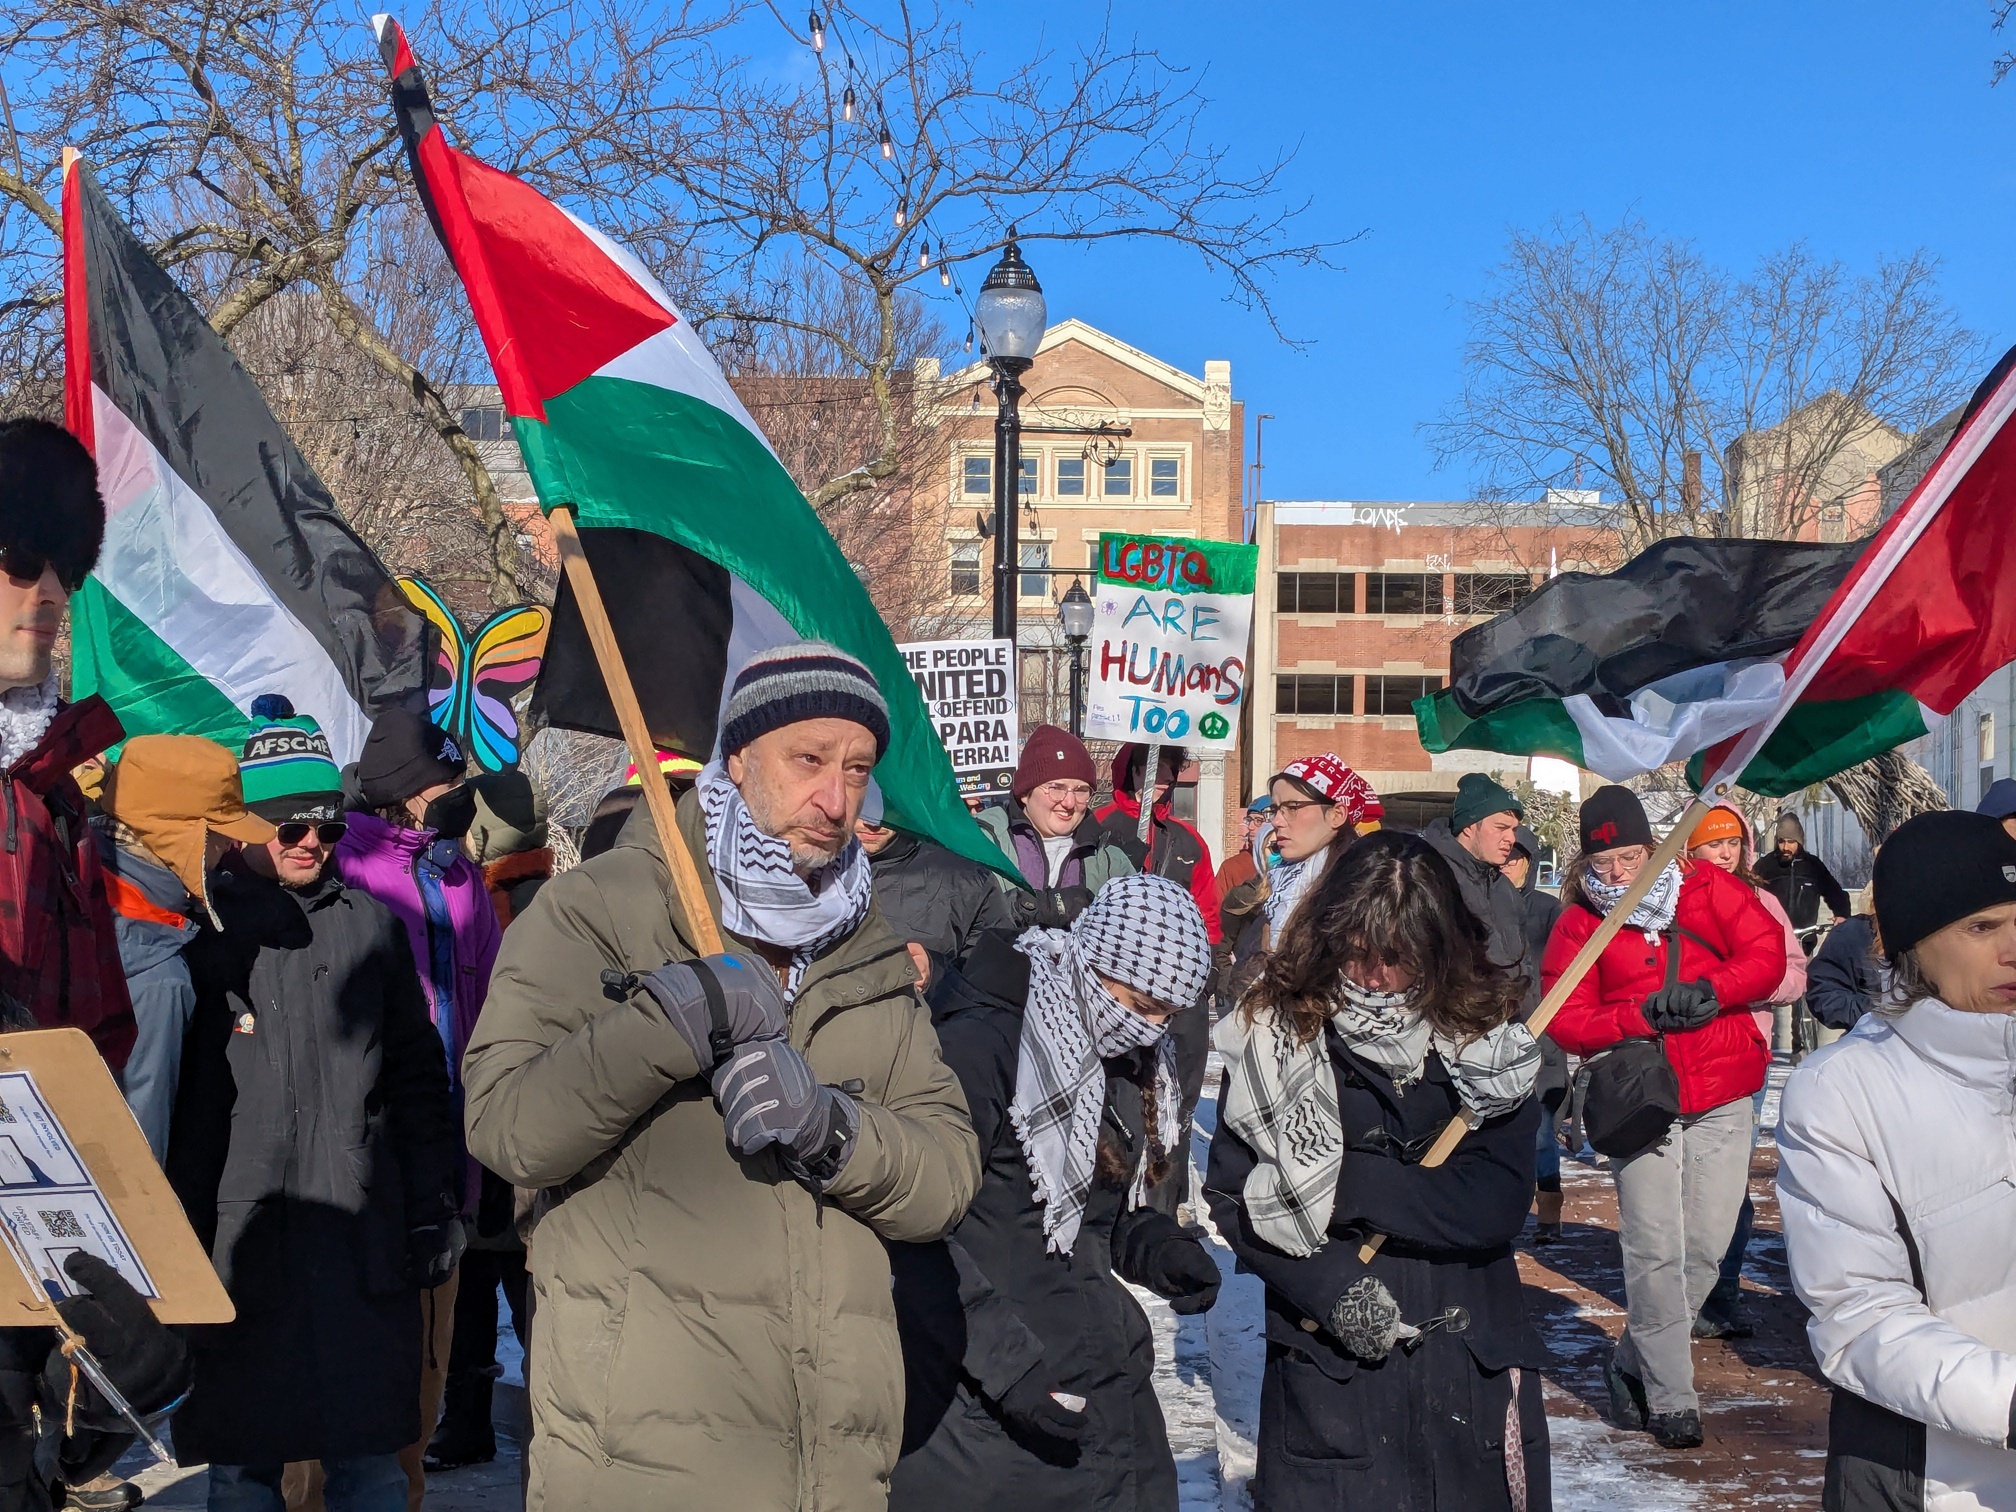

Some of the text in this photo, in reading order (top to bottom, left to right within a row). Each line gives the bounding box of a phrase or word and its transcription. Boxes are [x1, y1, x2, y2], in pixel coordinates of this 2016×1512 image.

[1103, 540, 1213, 586] LGBTQ
[1121, 595, 1221, 641] ARE
[900, 648, 1006, 669] HE PEOPLE
[911, 668, 1007, 701] NITED
[1119, 695, 1190, 739] TOO
[940, 719, 1009, 746] PARA
[249, 737, 330, 757] AFSCME
[946, 745, 1009, 766] IERRA!
[1321, 751, 1349, 772] ITY
